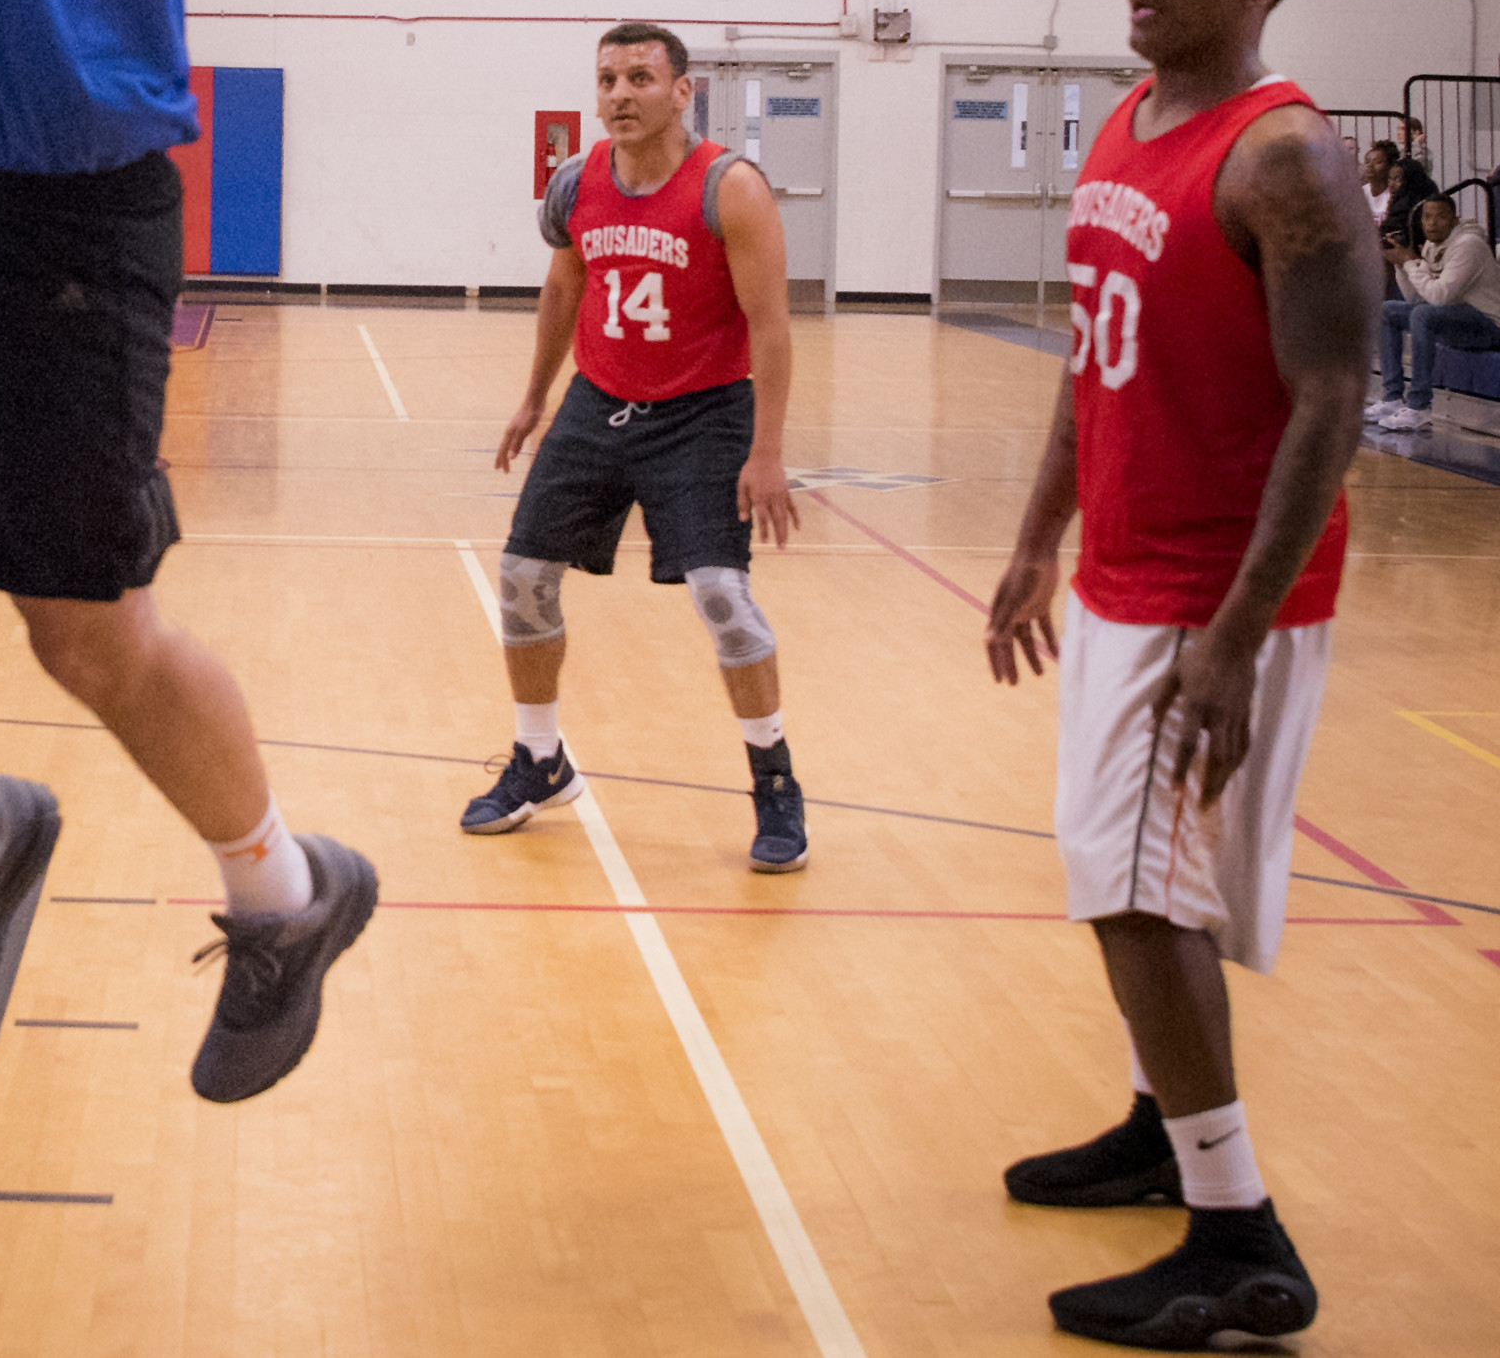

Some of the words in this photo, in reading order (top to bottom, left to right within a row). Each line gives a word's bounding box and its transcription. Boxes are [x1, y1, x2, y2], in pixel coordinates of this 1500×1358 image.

[581, 225, 689, 269] CRUSADERS
[603, 269, 671, 342] 14
[1067, 262, 1141, 390] 50
